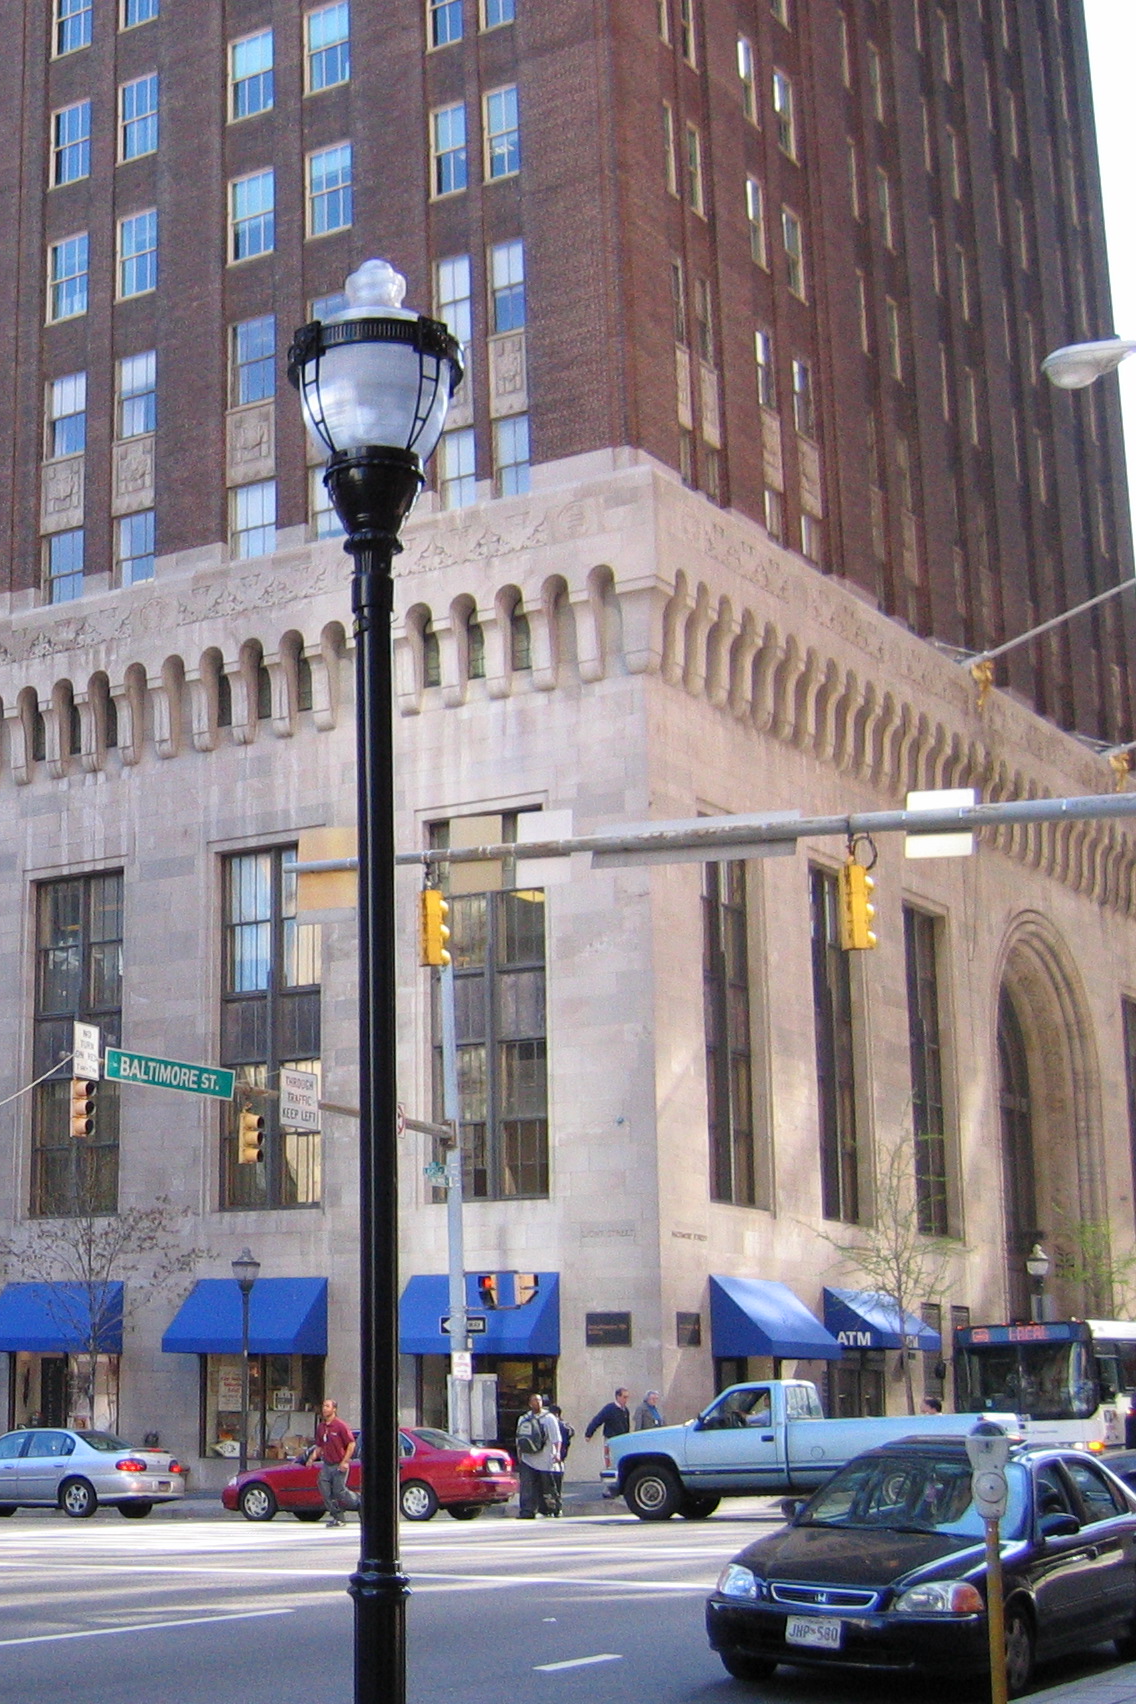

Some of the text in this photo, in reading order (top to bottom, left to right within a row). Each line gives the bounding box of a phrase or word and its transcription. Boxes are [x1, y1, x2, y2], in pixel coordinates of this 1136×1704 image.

[119, 1055, 220, 1091] BALTIMORE ST.
[282, 1107, 316, 1123] KEEP LEFT
[837, 1330, 872, 1347] ATM
